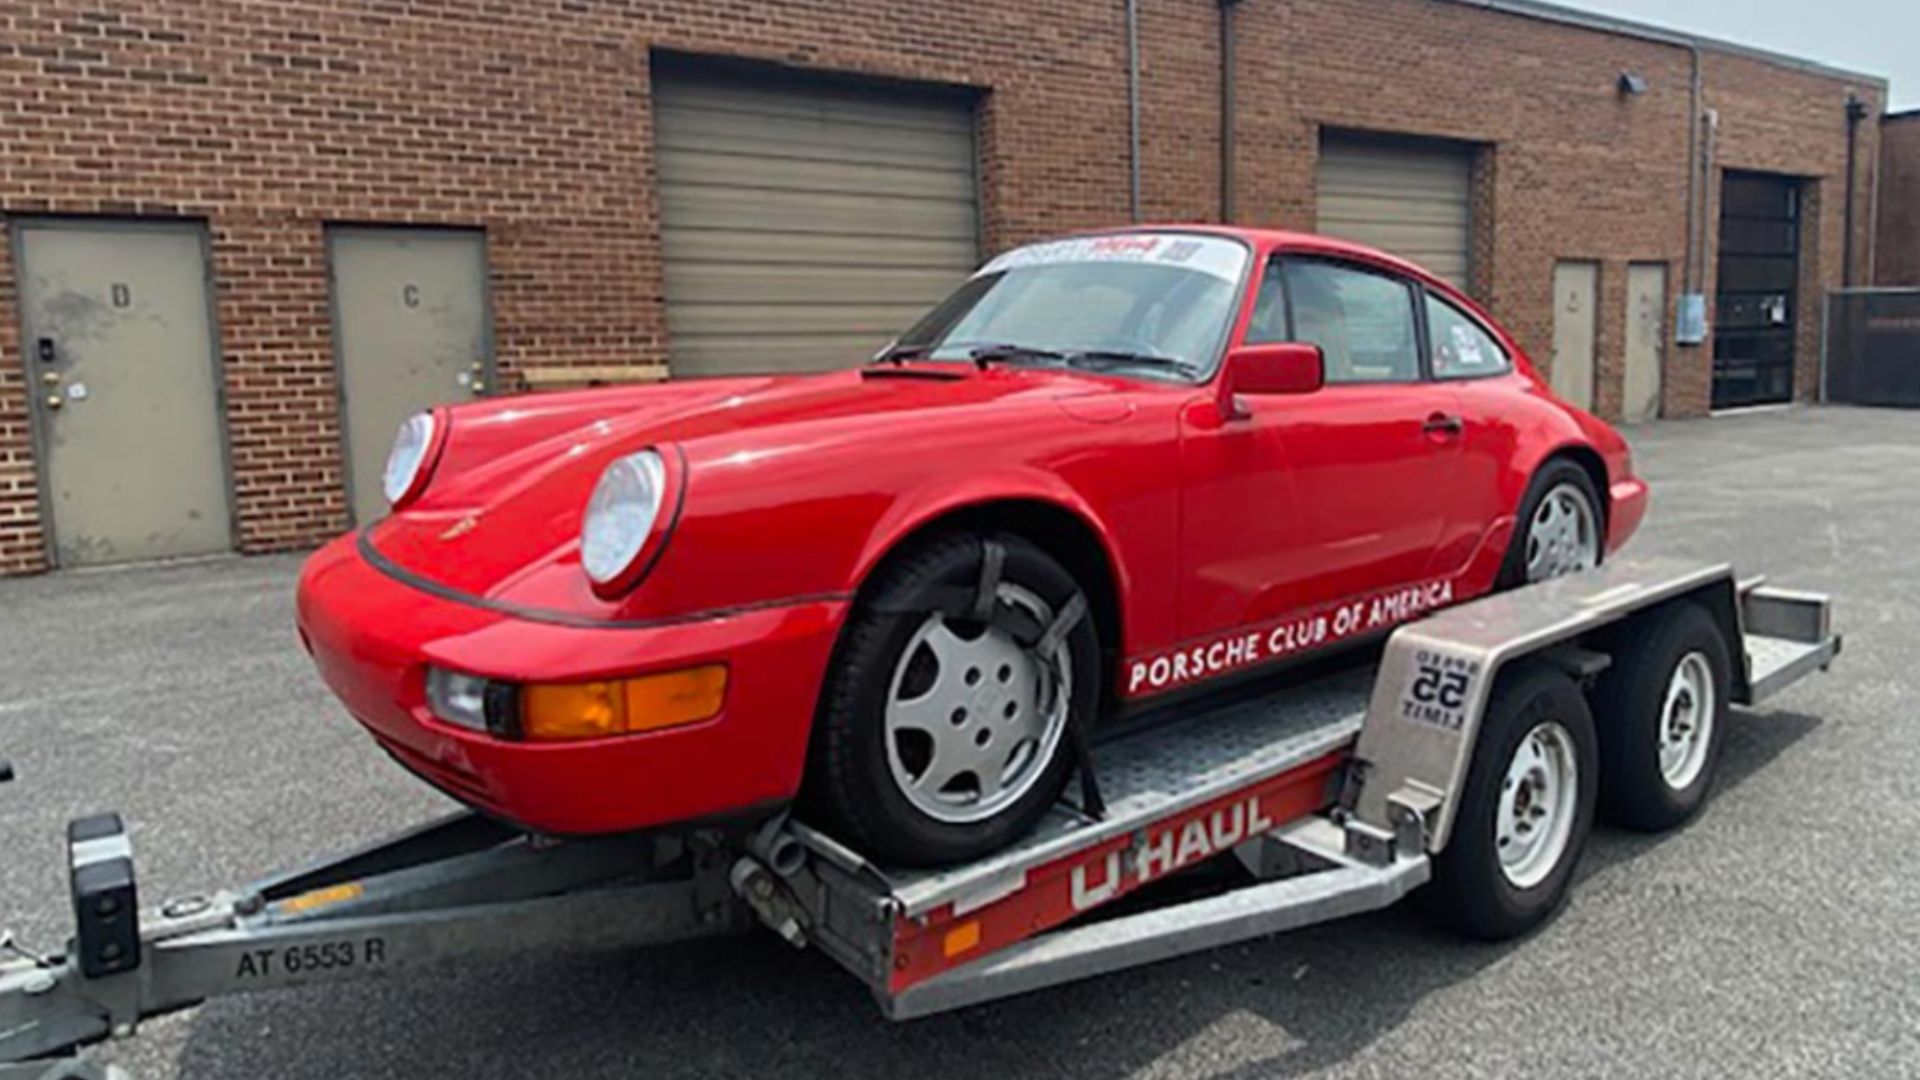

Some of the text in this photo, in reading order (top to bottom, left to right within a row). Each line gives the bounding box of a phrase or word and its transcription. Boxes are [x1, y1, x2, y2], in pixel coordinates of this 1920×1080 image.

[403, 285, 420, 308] C
[1128, 579, 1453, 693] PORSCHE CLUB OF AMERICA
[236, 937, 386, 977] AT 6553 R
